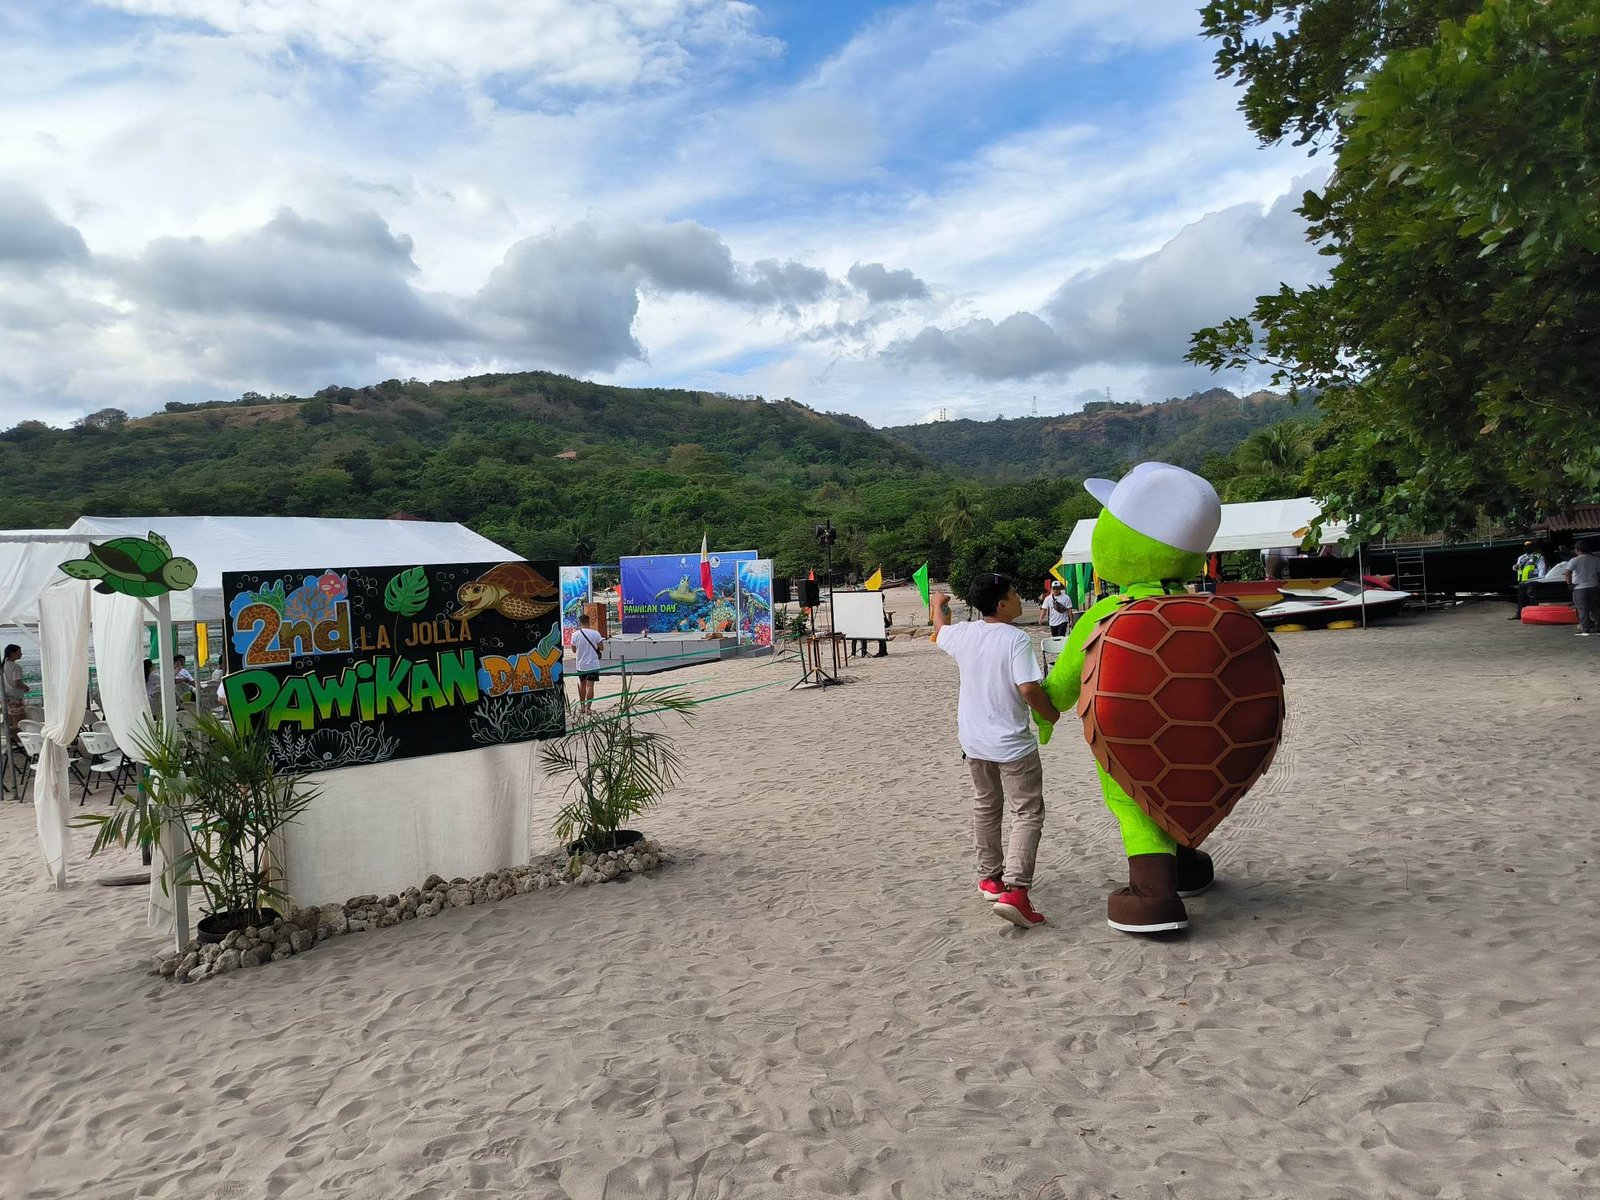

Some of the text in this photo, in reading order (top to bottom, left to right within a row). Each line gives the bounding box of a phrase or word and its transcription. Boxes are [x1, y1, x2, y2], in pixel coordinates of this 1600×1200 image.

[660, 603, 676, 613] DAY
[236, 600, 472, 667] 2nd LA JOLLA
[482, 647, 561, 697] DAY
